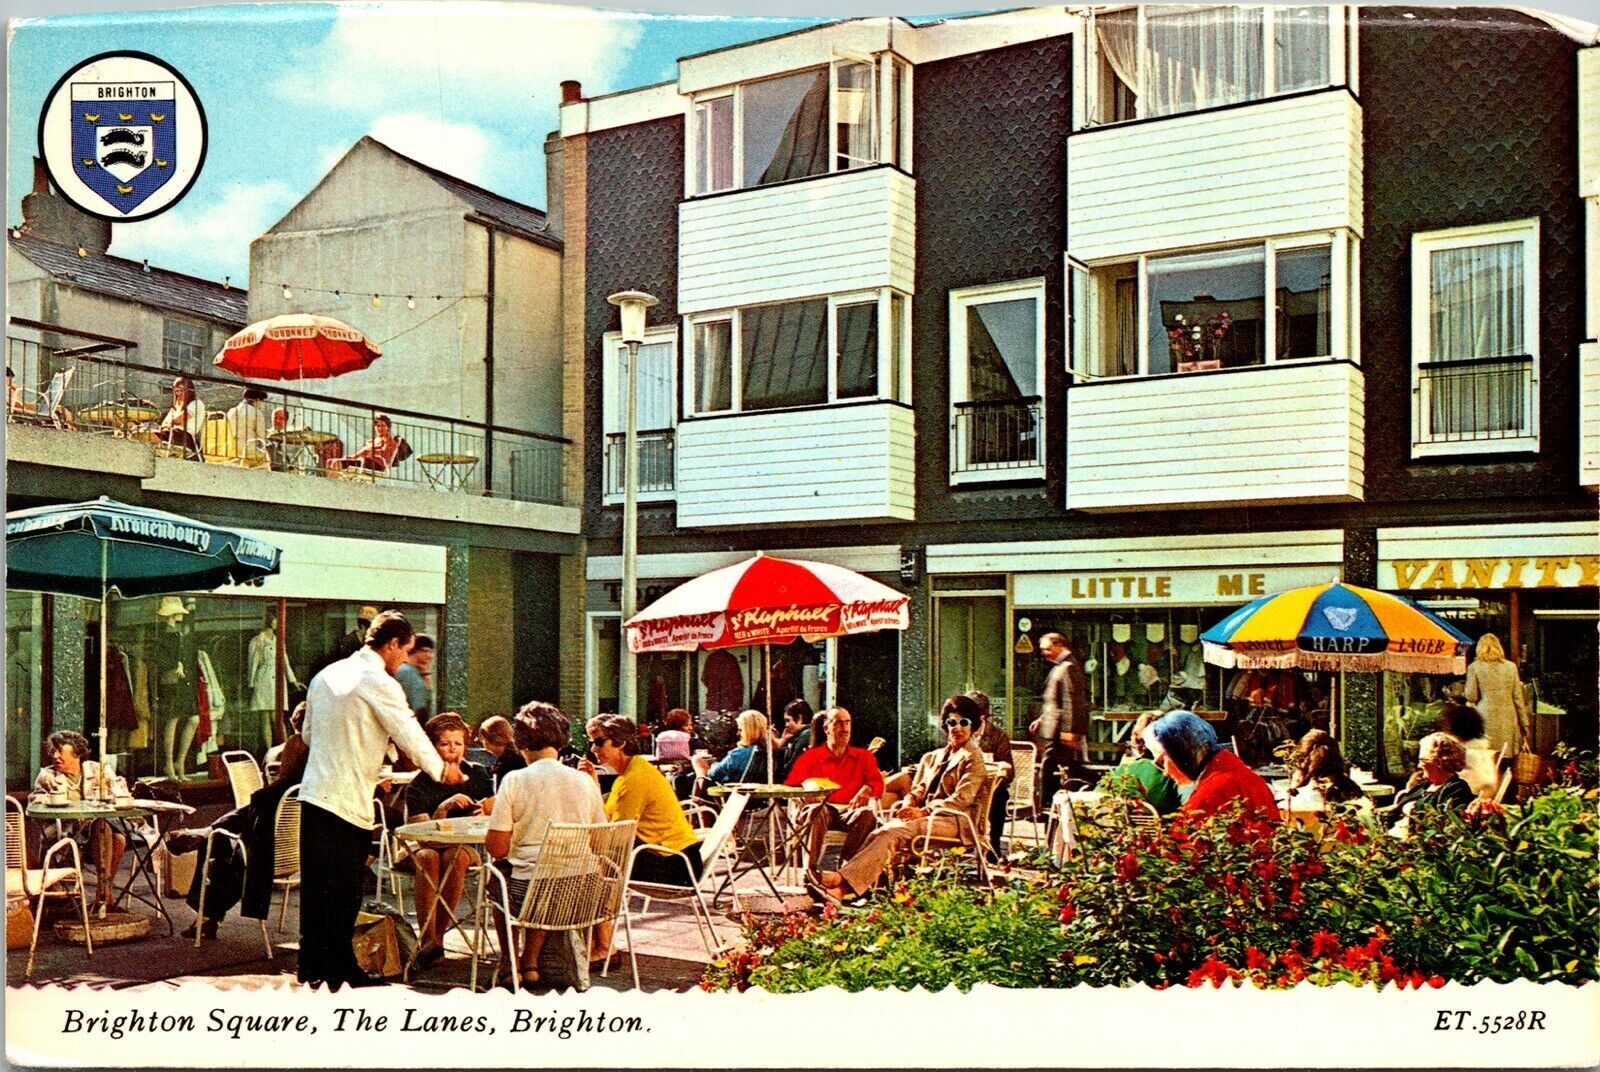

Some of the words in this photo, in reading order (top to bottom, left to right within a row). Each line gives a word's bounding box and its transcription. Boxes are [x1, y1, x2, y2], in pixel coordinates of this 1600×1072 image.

[110, 516, 211, 552] Kronenbourg
[1071, 576, 1171, 599] LITTLE
[1216, 573, 1266, 596] ME
[1312, 636, 1371, 653] HARP
[1399, 638, 1446, 655] LAGER
